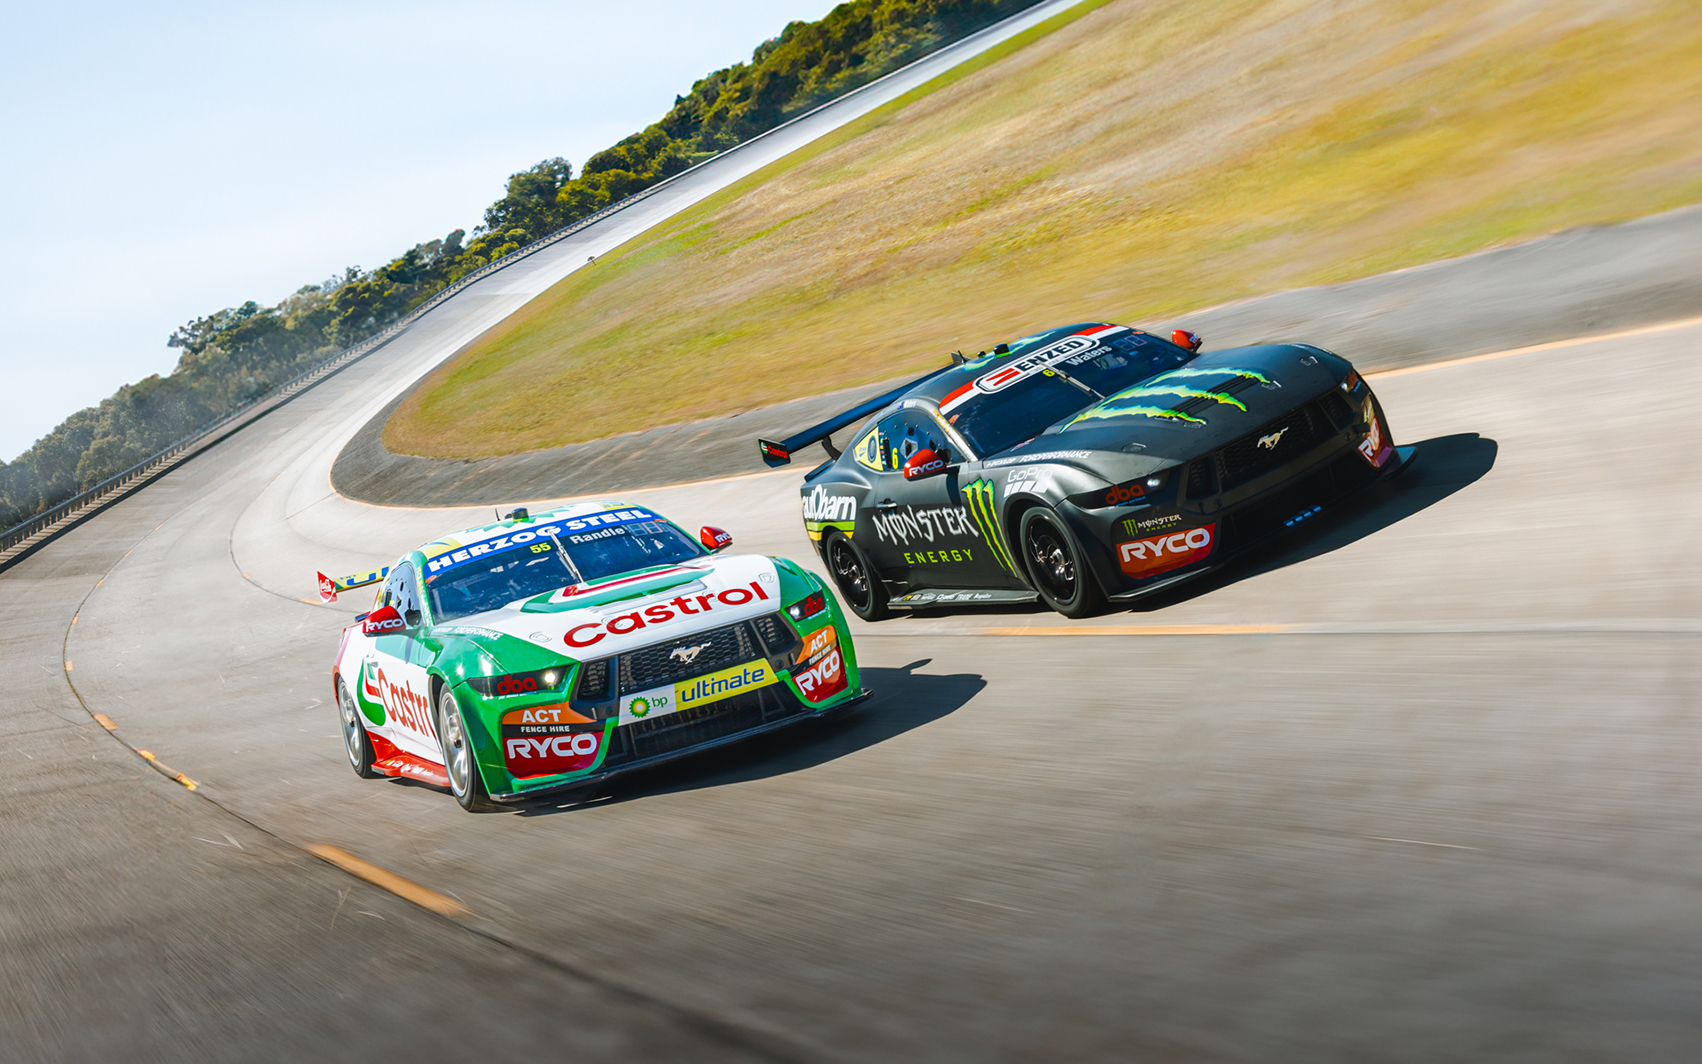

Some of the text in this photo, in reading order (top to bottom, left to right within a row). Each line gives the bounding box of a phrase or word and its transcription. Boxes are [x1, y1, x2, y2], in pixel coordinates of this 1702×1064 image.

[1014, 340, 1085, 372] ENZED
[1065, 345, 1113, 366] Waters
[1042, 369, 1055, 377] 6
[892, 447, 899, 470] 6
[908, 460, 944, 477] RYCO
[1007, 467, 1053, 483] GoPro
[1105, 484, 1145, 505] dba
[872, 504, 979, 546] MONSTER
[1137, 514, 1182, 529] MONSTER
[428, 510, 652, 572] HERZOG STEEL
[569, 525, 626, 544] Randle
[1120, 527, 1210, 563] RYCO
[530, 542, 551, 554] 55
[904, 549, 974, 564] ENERGY
[563, 581, 769, 648] Castrol
[804, 596, 824, 617] dba
[366, 618, 403, 633] RYCO
[810, 629, 828, 654] ACT
[795, 650, 840, 696] RYCO
[497, 674, 537, 695] dba
[651, 668, 765, 708] bp ultimate
[522, 709, 561, 723] ACT
[507, 733, 597, 759] RYCO
